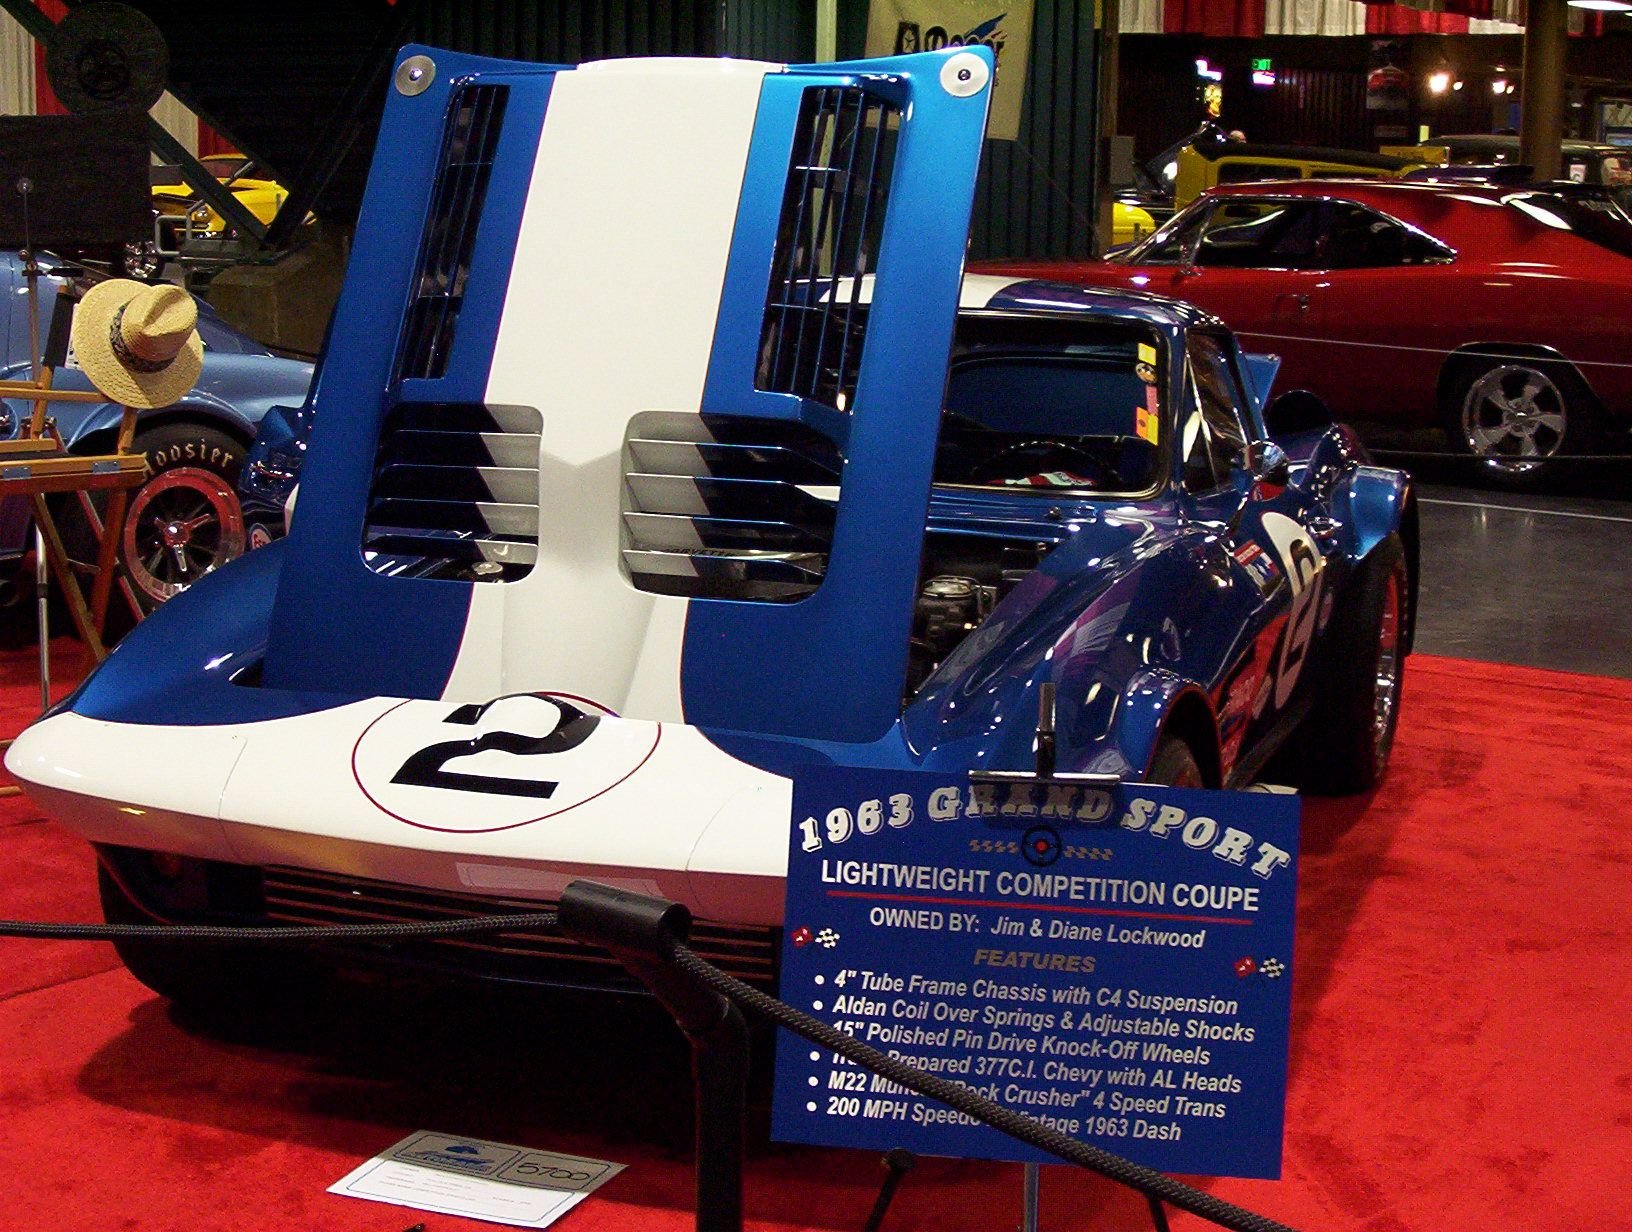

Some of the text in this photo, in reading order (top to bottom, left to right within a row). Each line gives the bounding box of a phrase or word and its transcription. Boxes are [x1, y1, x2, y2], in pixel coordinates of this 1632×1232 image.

[389, 692, 601, 799] 2
[799, 783, 1292, 880] 1963 GRAND SPORT
[821, 859, 1260, 912] LIGHTWEIGHT COMPETITION COUPE
[869, 906, 1207, 948] OWNED BY: Jim & Diane Lockwood
[973, 948, 1097, 974] FEATURES
[834, 968, 1239, 1015] 4" Tube Frame Chassis with C4 Suspension
[832, 994, 1256, 1042] Aldan Coil Over Springs & Adjustable Shocks
[866, 1022, 949, 1047] Polished
[952, 1029, 983, 1050] Pin
[987, 1031, 1037, 1053] Drive
[1041, 1035, 1140, 1060] Knock-Off
[1142, 1041, 1211, 1066] Wheels
[828, 1070, 867, 1092] M22
[1004, 1083, 1091, 1108] Crusher"
[1092, 1091, 1105, 1109] 4
[1109, 1091, 1170, 1116] Speed
[1175, 1096, 1227, 1118] Trans
[974, 1056, 1037, 1079] 377C.I.
[1043, 1061, 1103, 1087] Chevy
[1107, 1067, 1146, 1087] with
[1150, 1069, 1177, 1089] AL
[1182, 1071, 1242, 1093] Heads
[826, 1095, 860, 1117] 200
[863, 1099, 908, 1121] MPH
[1086, 1116, 1128, 1137] 1963
[1132, 1119, 1182, 1141] Dash
